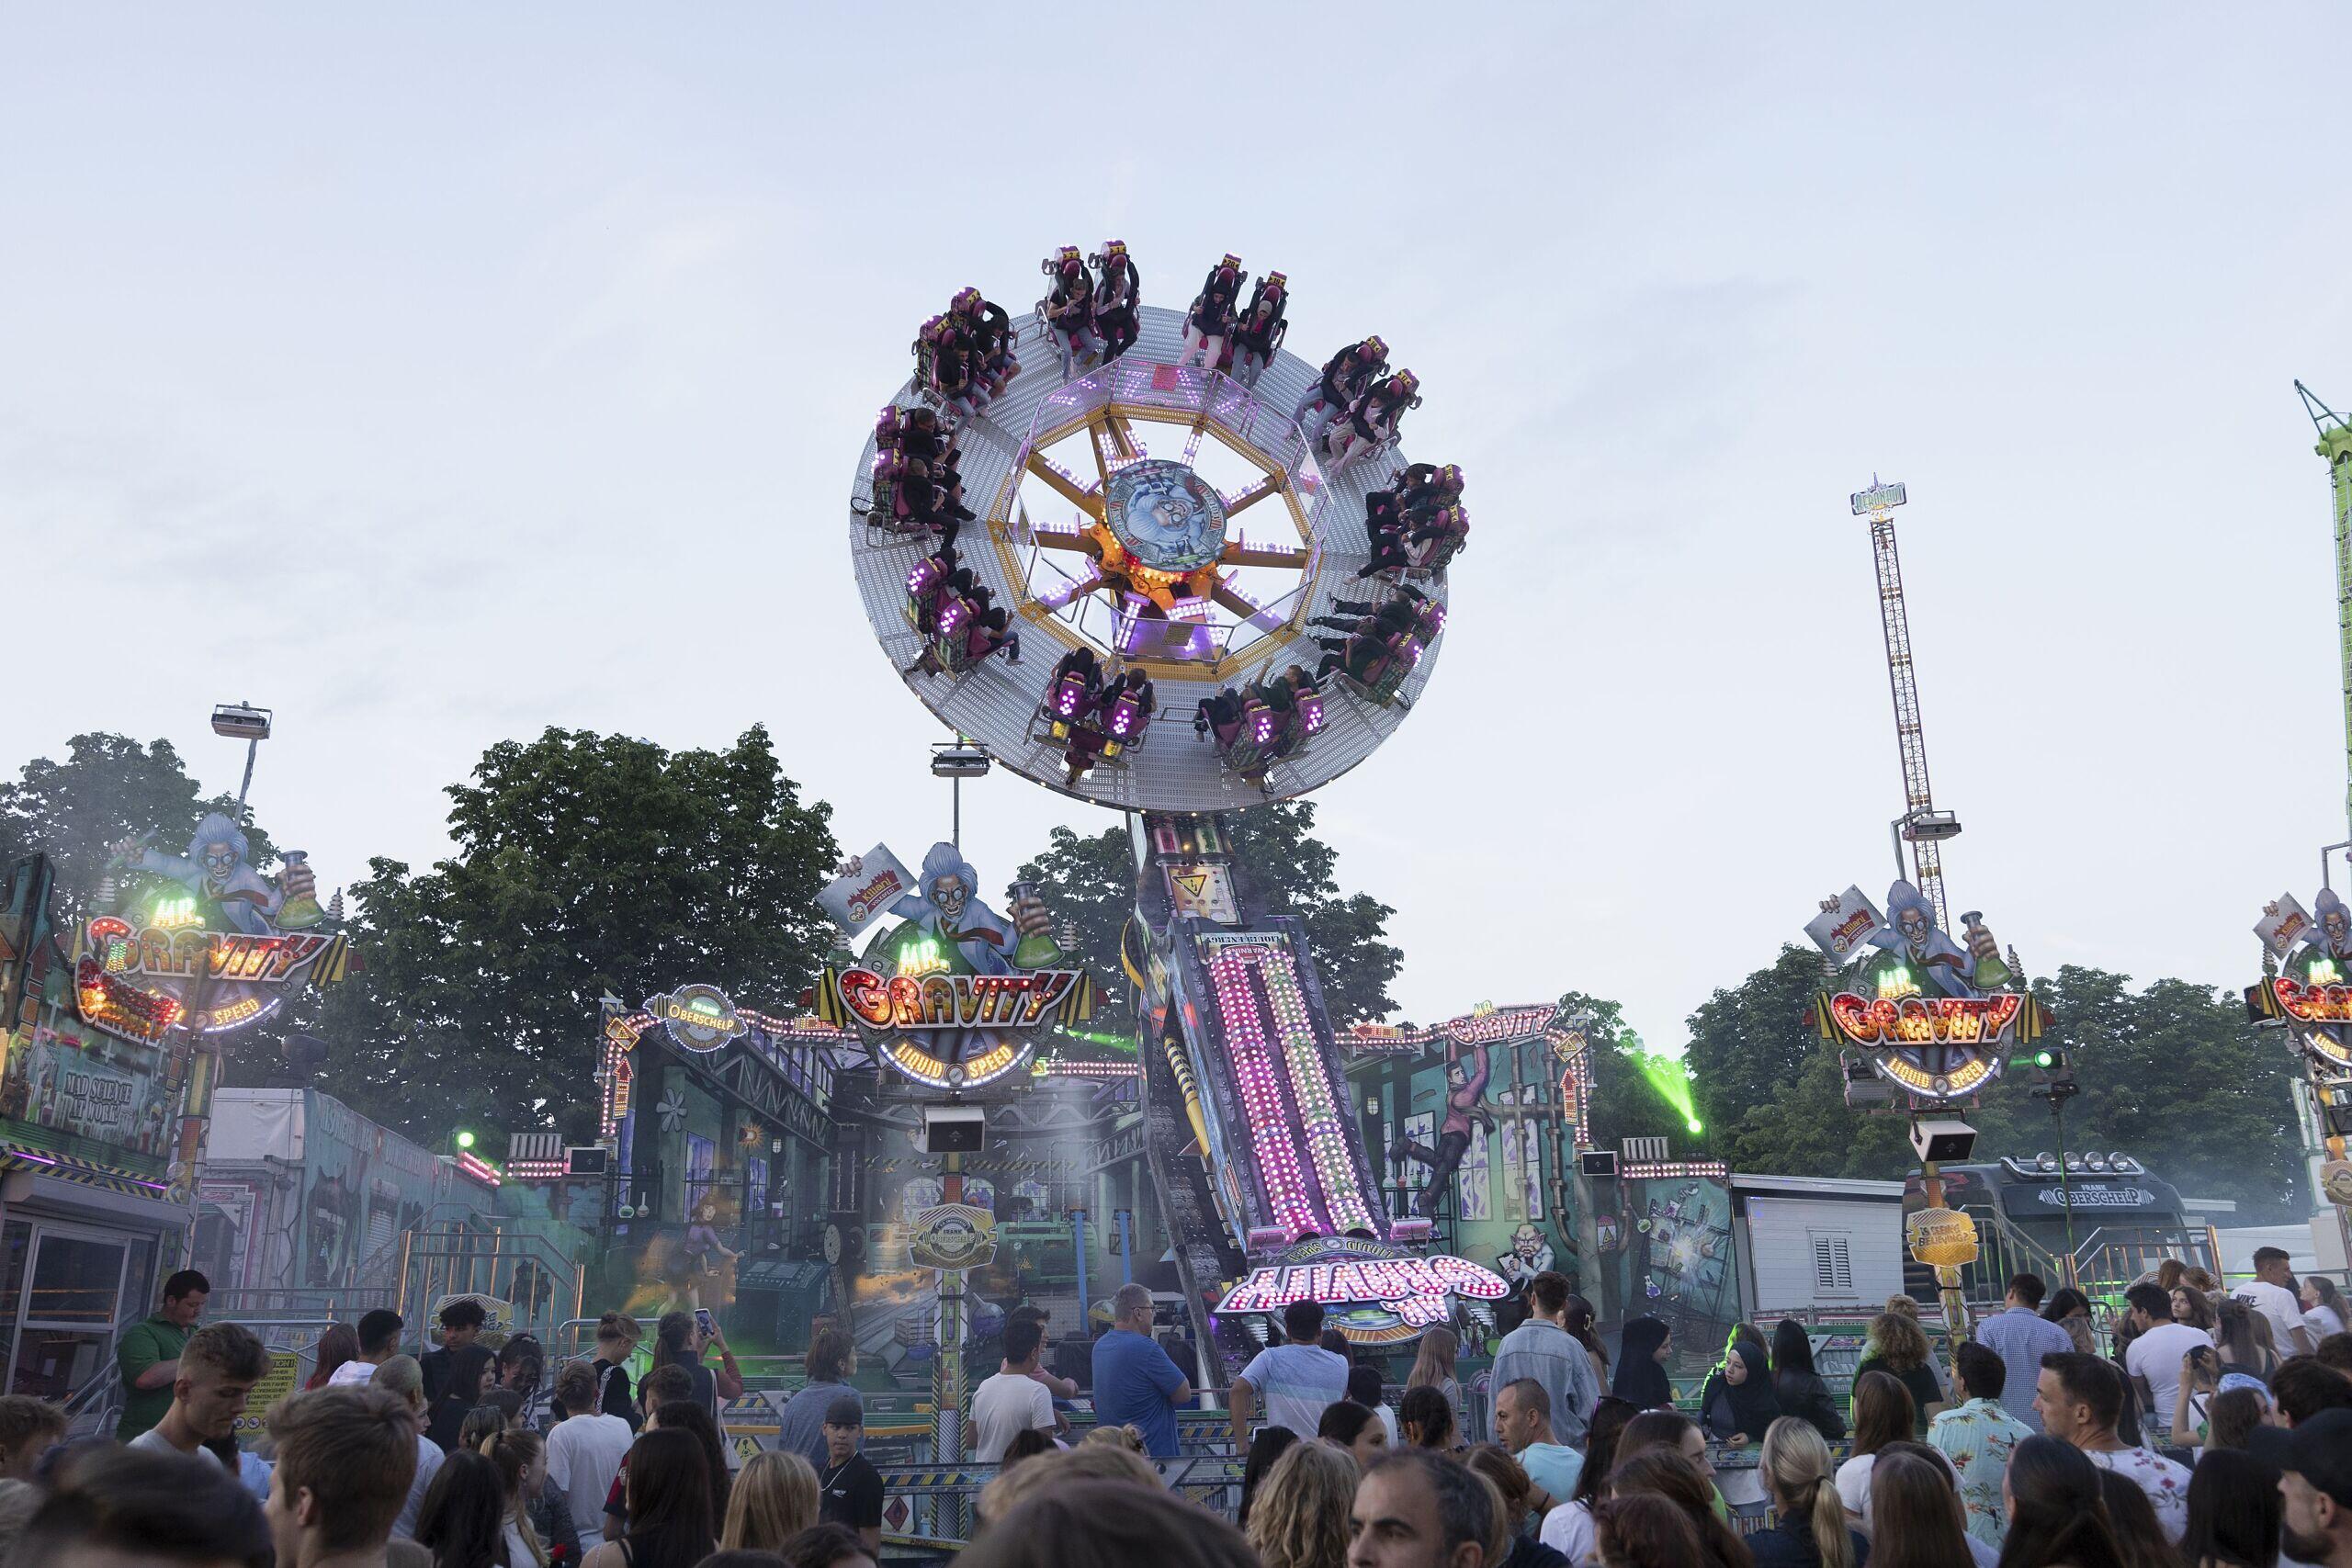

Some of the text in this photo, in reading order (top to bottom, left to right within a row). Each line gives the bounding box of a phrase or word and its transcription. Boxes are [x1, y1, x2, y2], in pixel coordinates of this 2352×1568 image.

[863, 877, 894, 901] Kiliani
[150, 897, 206, 929] MR.
[1842, 915, 1867, 935] Kiliani
[899, 939, 951, 976] MR.
[837, 968, 1082, 1028] GRAVITY
[1879, 967, 1922, 998] MR.
[213, 998, 260, 1026] SPEED
[669, 1004, 734, 1030] OBERSCHELP
[691, 1001, 719, 1016] FRANK
[1831, 992, 2025, 1046] GRAVITY
[1448, 1005, 1561, 1045] GRAVITY
[895, 1043, 1012, 1079] LIQUID SPEED
[1888, 1057, 1985, 1089] LIQUID SPEED
[64, 1072, 132, 1103] MAD SCIENCE
[70, 1098, 85, 1118] AT
[2053, 1188, 2141, 1206] OBERSCHELP
[1346, 1240, 1394, 1258] LIQUID
[1918, 1232, 1969, 1247] BELIEVING?
[1215, 1255, 1510, 1313] GRAVITY
[2236, 1294, 2256, 1305] NIKE
[1380, 1295, 1450, 1326] MR.
